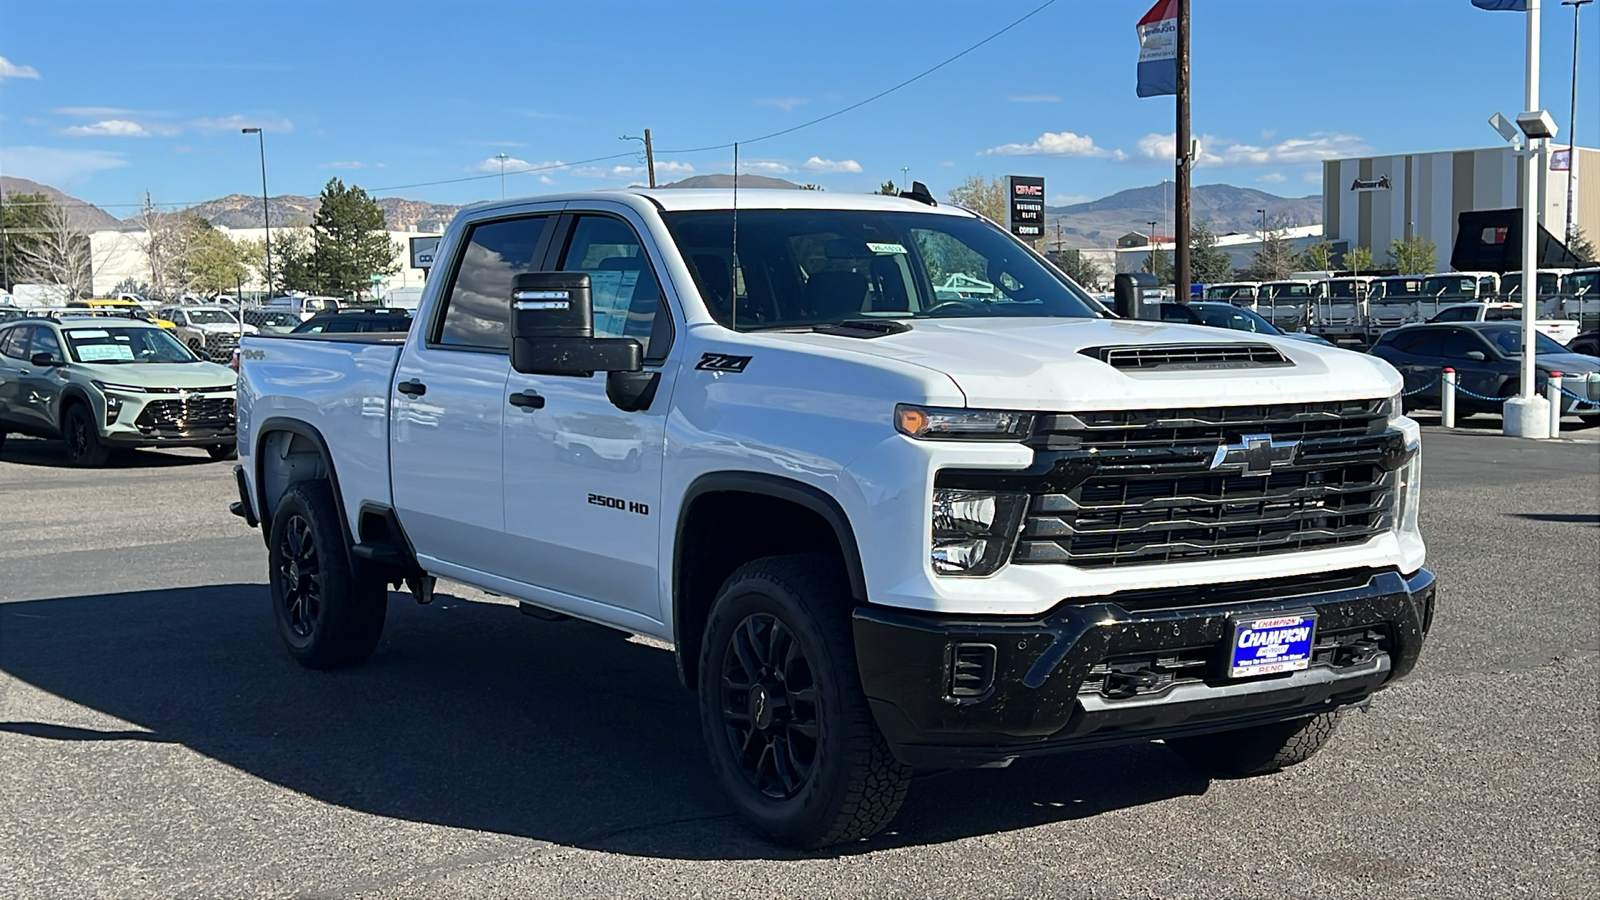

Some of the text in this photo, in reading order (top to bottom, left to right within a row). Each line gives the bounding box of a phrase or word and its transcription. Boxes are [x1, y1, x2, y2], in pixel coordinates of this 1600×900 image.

[1015, 185, 1042, 195] GMC
[1022, 211, 1037, 219] ELITE
[694, 352, 753, 373] Z71
[588, 493, 649, 515] 2500 HD
[1257, 617, 1297, 628] CHAMPION
[1238, 627, 1310, 648] CHAMPION
[1258, 664, 1284, 673] RENO
